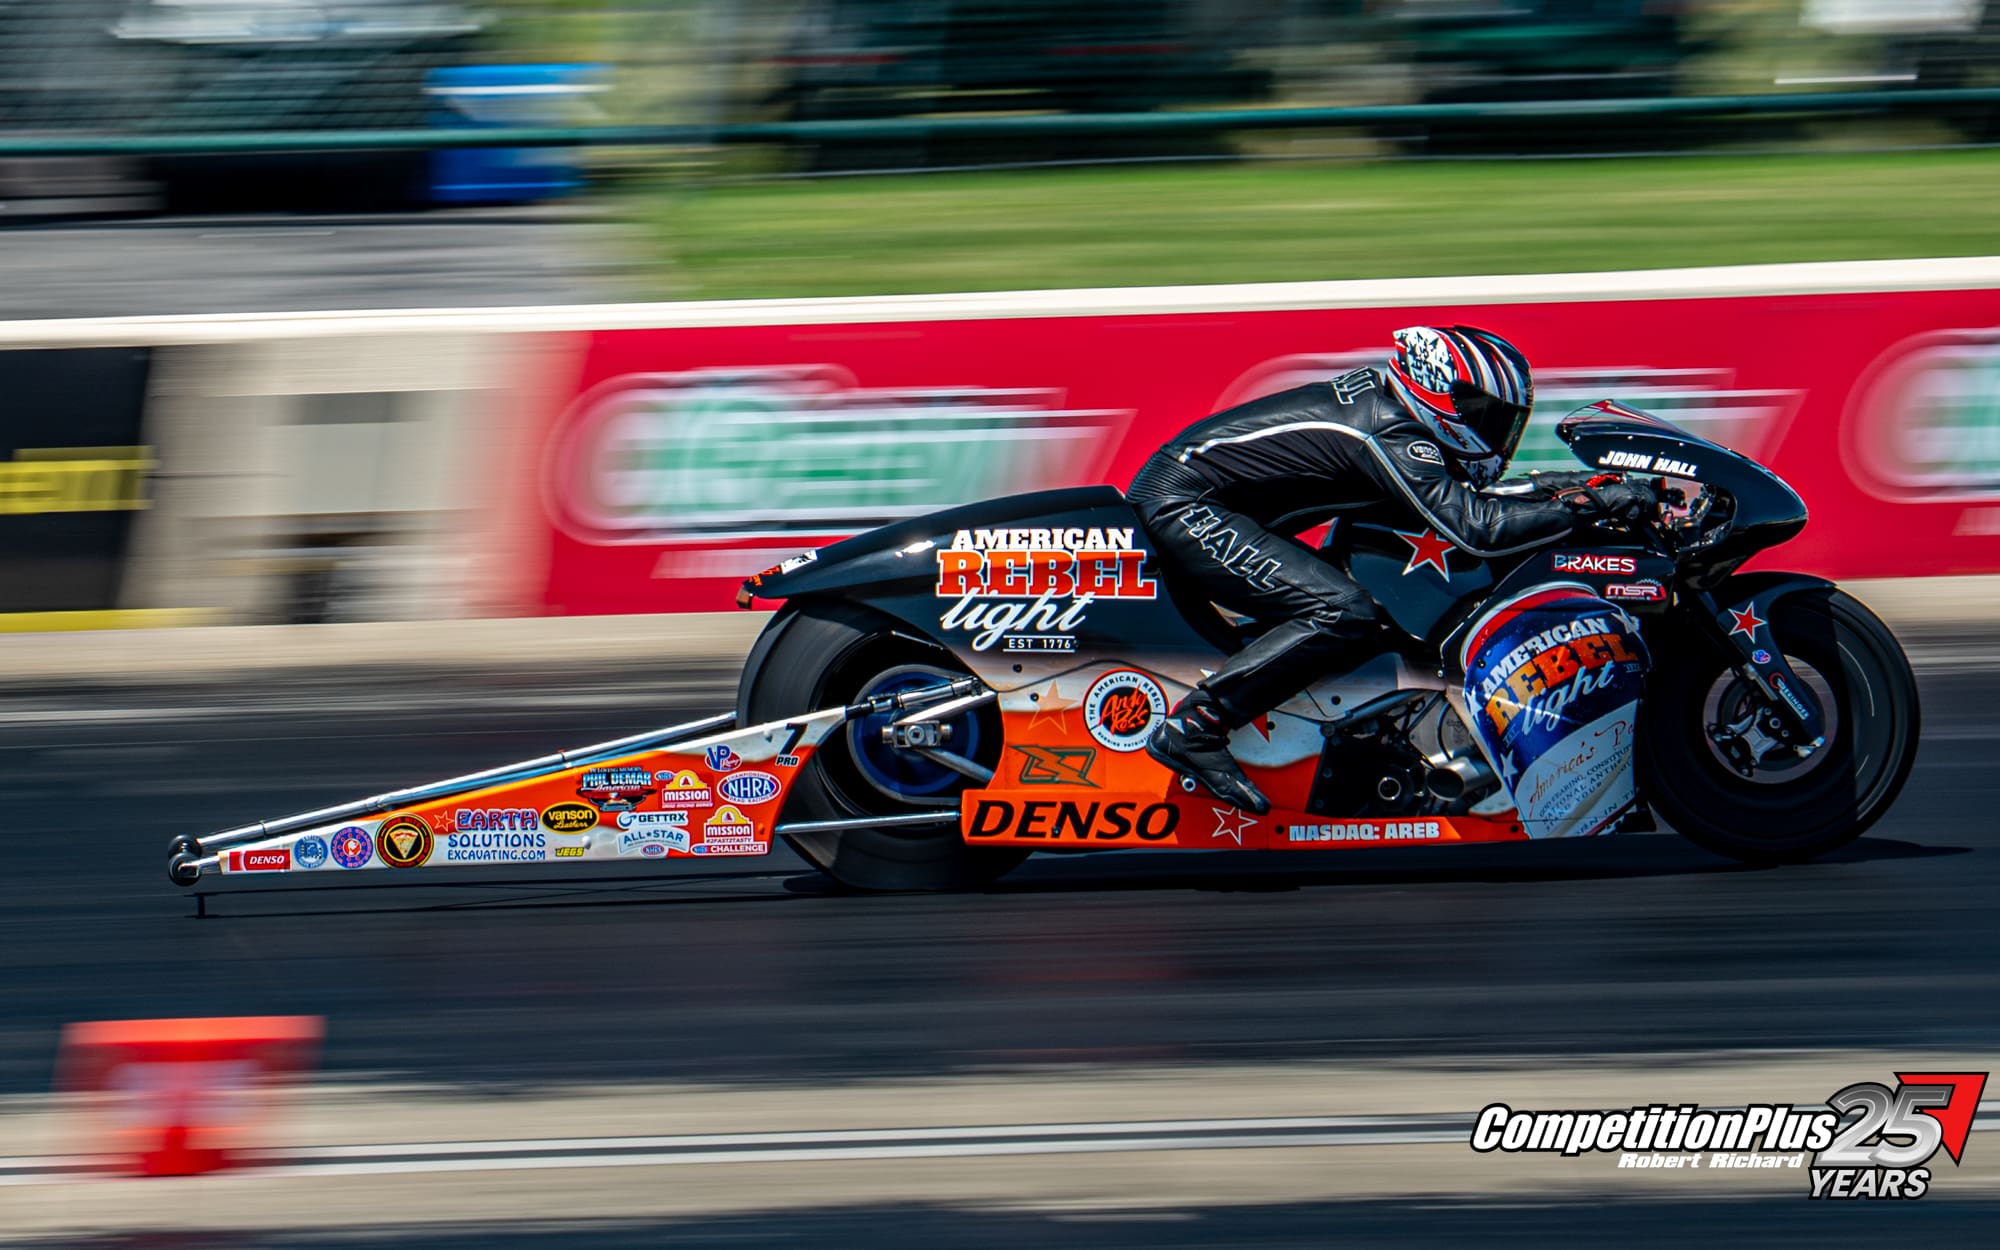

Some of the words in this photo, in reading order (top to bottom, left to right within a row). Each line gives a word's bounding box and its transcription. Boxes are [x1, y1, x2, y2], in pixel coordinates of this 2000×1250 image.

[1599, 450, 1654, 469] JOHN
[1653, 457, 1697, 477] HALL
[951, 528, 1135, 551] AMERICAN
[1180, 504, 1283, 592] HALL
[936, 549, 1157, 600] REBEL
[1553, 554, 1636, 573] BRAKES
[940, 587, 1096, 651] light
[1008, 638, 1034, 649] EST
[1042, 638, 1072, 649] 1776
[1481, 618, 1610, 700] AMERICAN
[1094, 675, 1139, 698] AMERICAN
[1143, 682, 1162, 708] REBEL
[1485, 634, 1638, 737] REBEL
[1522, 660, 1616, 736] light
[779, 722, 808, 755] 7
[706, 744, 731, 771] VP
[776, 756, 799, 766] PRO
[582, 773, 610, 789] PHIL
[610, 771, 652, 786] DEMAR
[727, 777, 773, 798] NHRA
[454, 808, 538, 832] EARTH
[547, 809, 593, 821] vanson
[638, 812, 686, 823] GETTRX
[967, 800, 1181, 841] DENSO
[447, 833, 546, 849] SOLUTIONS
[1289, 823, 1381, 841] NASDAQ:
[1385, 821, 1441, 840] AREB
[447, 849, 546, 861] EXCAVATING.COM
[555, 847, 585, 857] JEGS
[710, 844, 764, 854] CHALLENGE
[249, 855, 285, 866] DENSO
